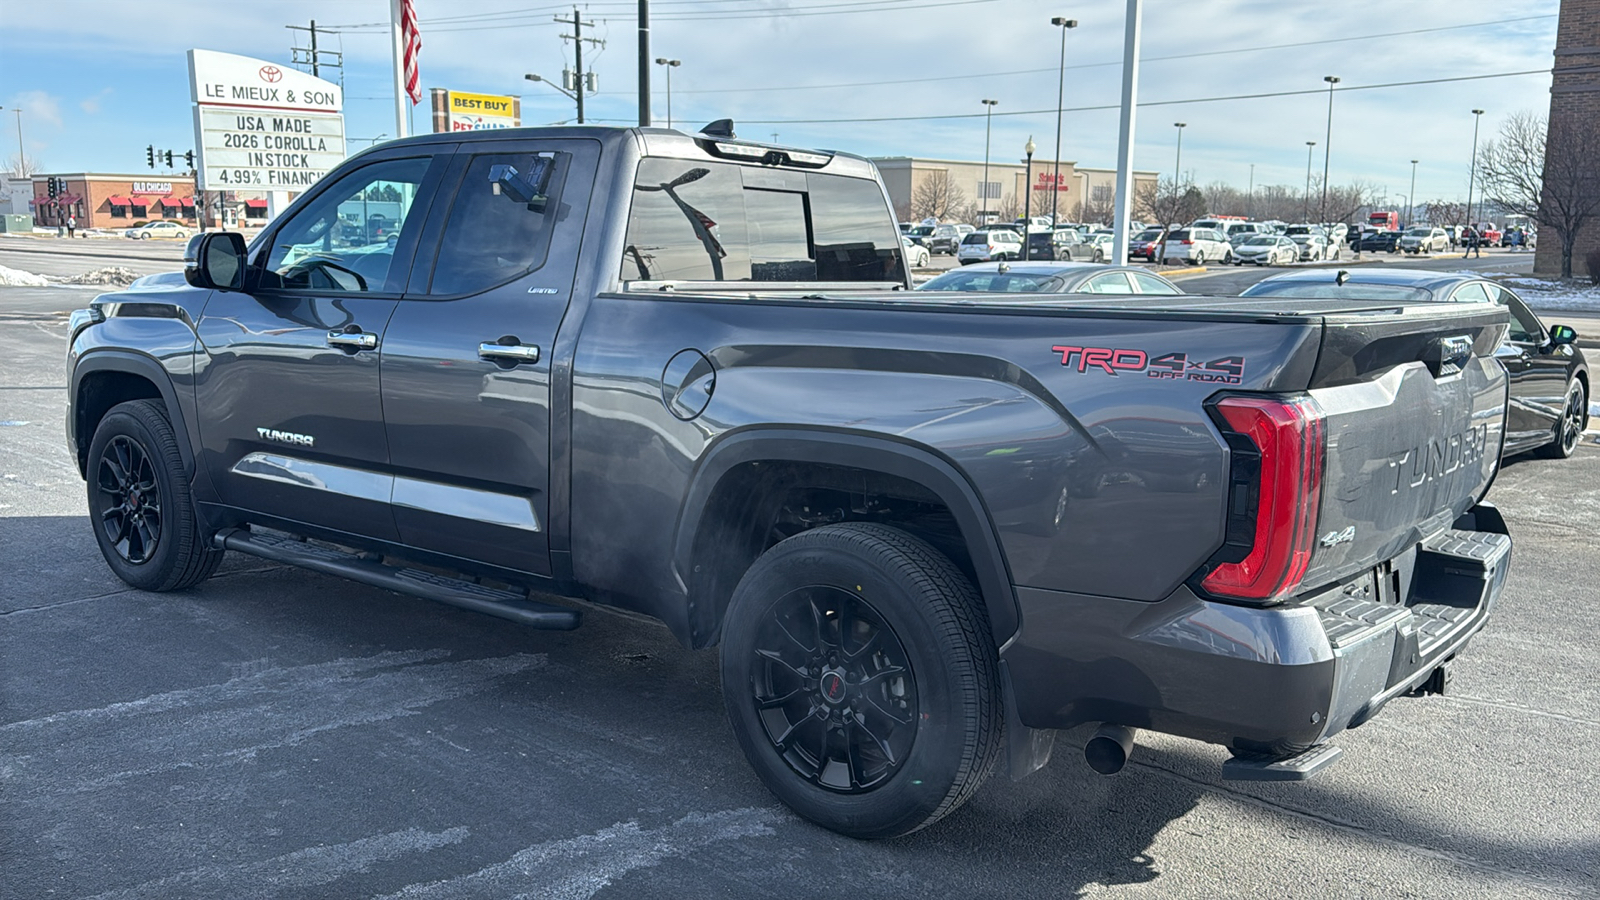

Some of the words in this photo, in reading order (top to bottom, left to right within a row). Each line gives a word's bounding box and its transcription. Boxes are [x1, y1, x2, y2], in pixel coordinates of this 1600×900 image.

[205, 83, 225, 98] LE
[232, 86, 280, 102] MIEUX
[286, 89, 297, 103] &
[303, 91, 335, 106] SON
[454, 98, 482, 109] BEST
[484, 100, 509, 111] BUY
[236, 116, 265, 132] USA
[273, 117, 312, 134] MADE
[453, 120, 511, 132] PETSMA
[223, 133, 259, 149] 2026
[264, 135, 327, 152] COROLLA
[219, 169, 261, 185] 4.99%
[268, 170, 325, 185] FINANCI
[133, 182, 146, 191] OLD
[146, 182, 172, 192] CHICAGO
[1051, 345, 1149, 377] TRD
[1147, 370, 1185, 380] OFF
[1187, 373, 1242, 385] ROAD
[256, 427, 315, 447] TUNDRA
[1388, 422, 1488, 495] TUNDRA
